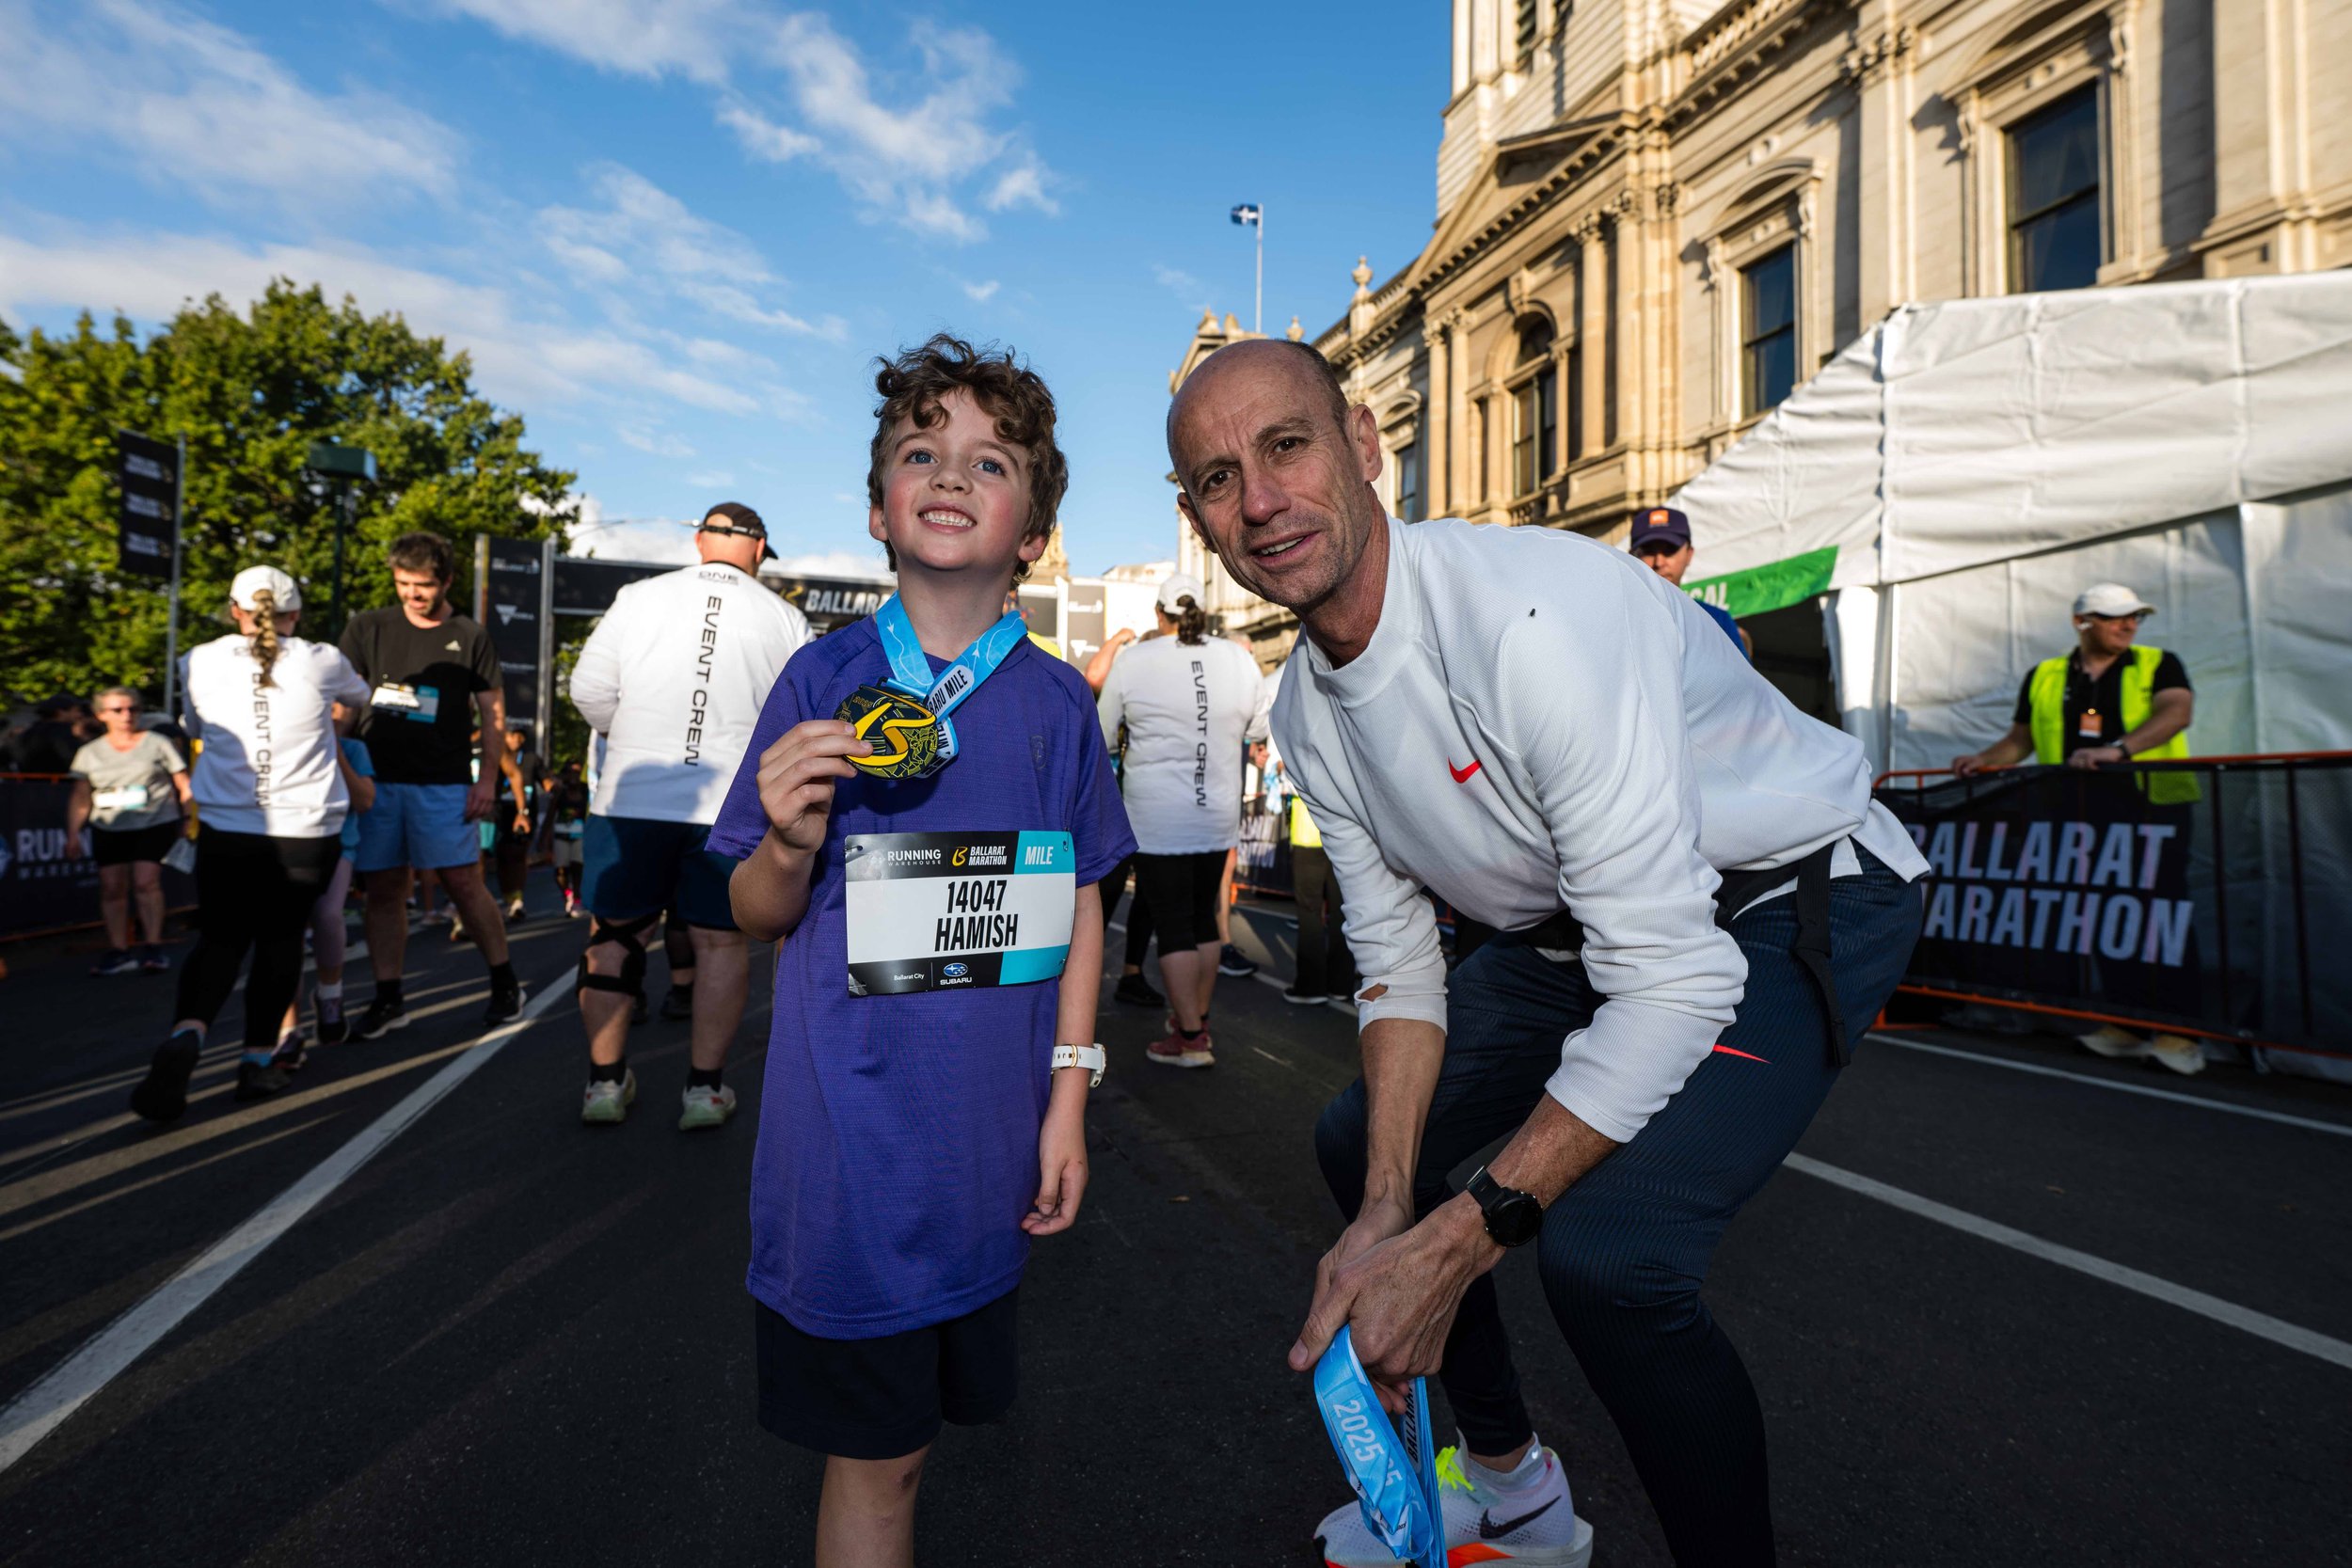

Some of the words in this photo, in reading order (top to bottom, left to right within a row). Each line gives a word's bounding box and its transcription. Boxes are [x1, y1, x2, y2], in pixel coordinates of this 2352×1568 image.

[696, 594, 723, 684] EVENT
[944, 669, 968, 699] MILE
[1191, 660, 1209, 736] EVENT
[252, 673, 271, 743] EVENT
[684, 689, 707, 767] CREW
[255, 749, 272, 808] CREW
[1194, 741, 1208, 807] CREW
[887, 848, 942, 862] RUNNING
[968, 855, 1008, 866] MARATHON
[970, 846, 1007, 857] BALLARAT
[1025, 846, 1055, 865] MILE
[946, 879, 1008, 914] 14047
[934, 913, 1019, 952] HAMISH
[1921, 881, 2195, 968] ARATHON
[894, 973, 914, 981] Ballarat
[914, 972, 925, 981] City
[940, 976, 973, 986] SUBARU
[1332, 1399, 1386, 1463] 2025
